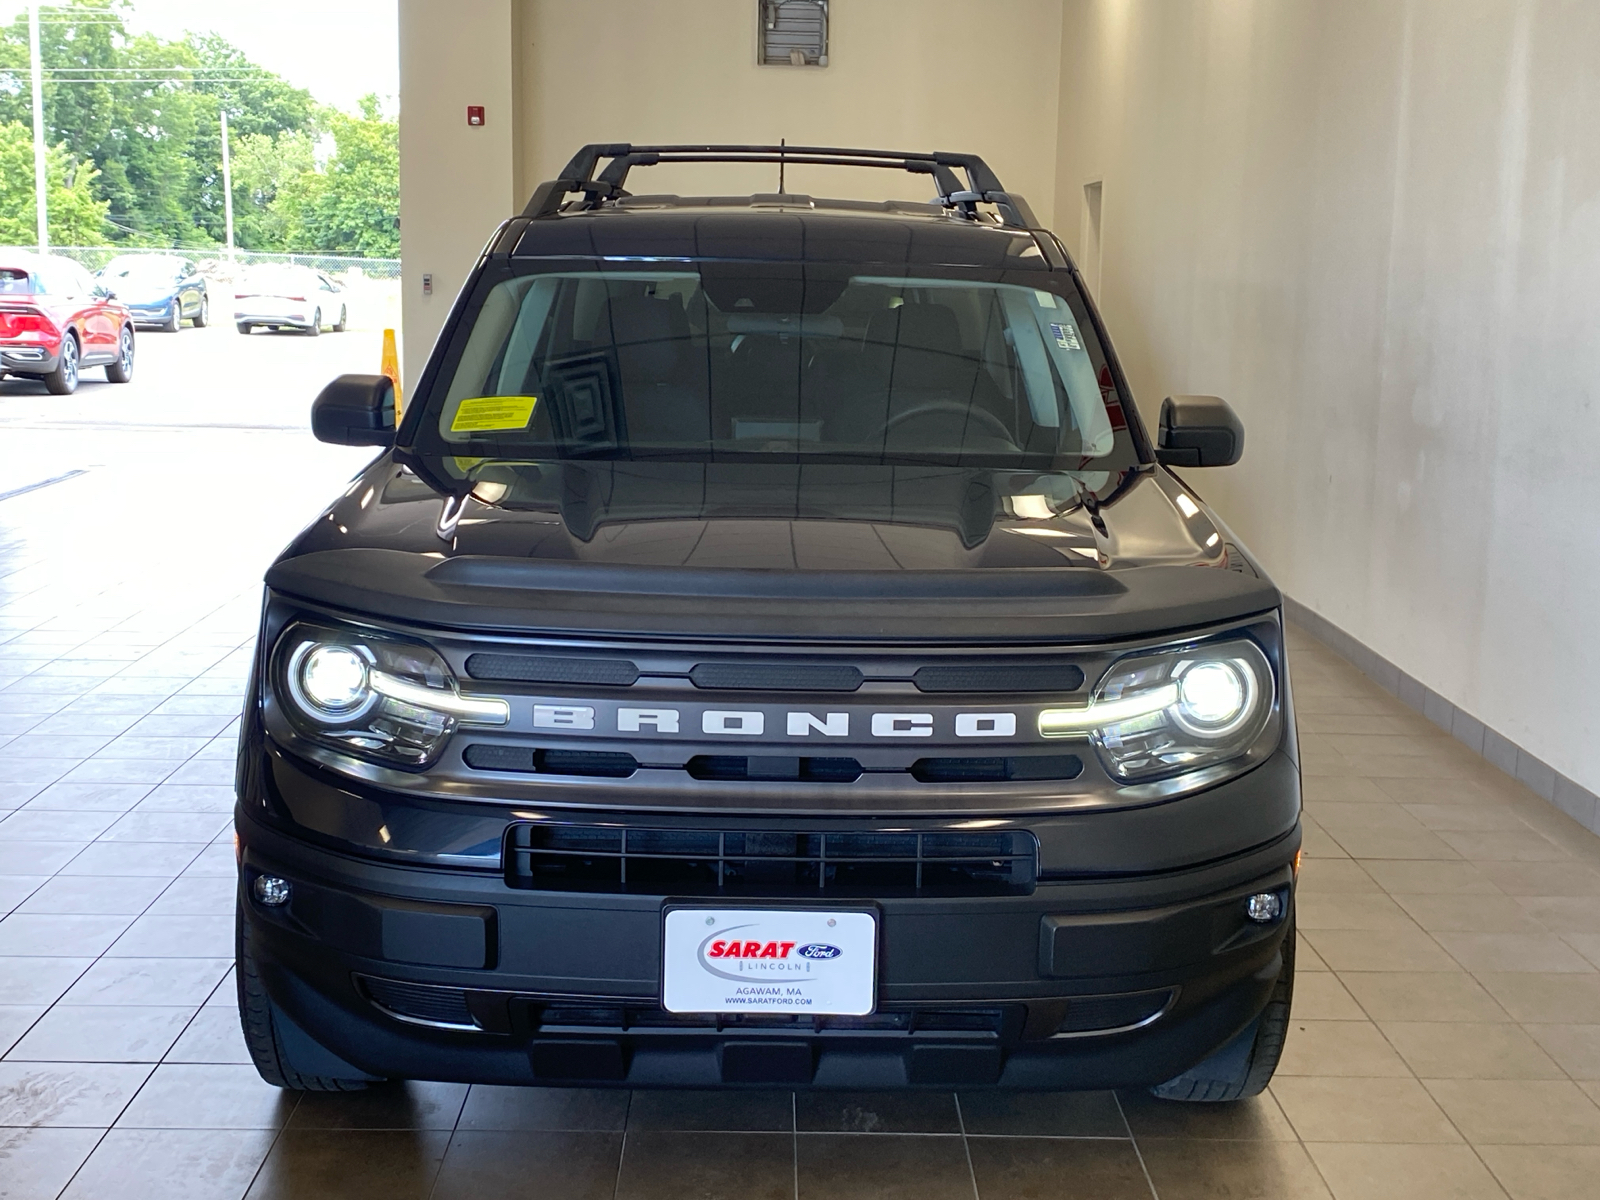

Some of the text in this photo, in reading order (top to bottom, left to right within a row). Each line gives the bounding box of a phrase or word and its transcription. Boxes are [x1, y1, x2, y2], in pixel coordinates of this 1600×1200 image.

[533, 704, 1016, 737] BRONCO
[708, 940, 834, 959] SARAT Ford
[748, 962, 801, 971] LINCOLN
[735, 987, 802, 996] AGAWAM, MA
[725, 997, 812, 1005] WWW.SARATFORD.COM
